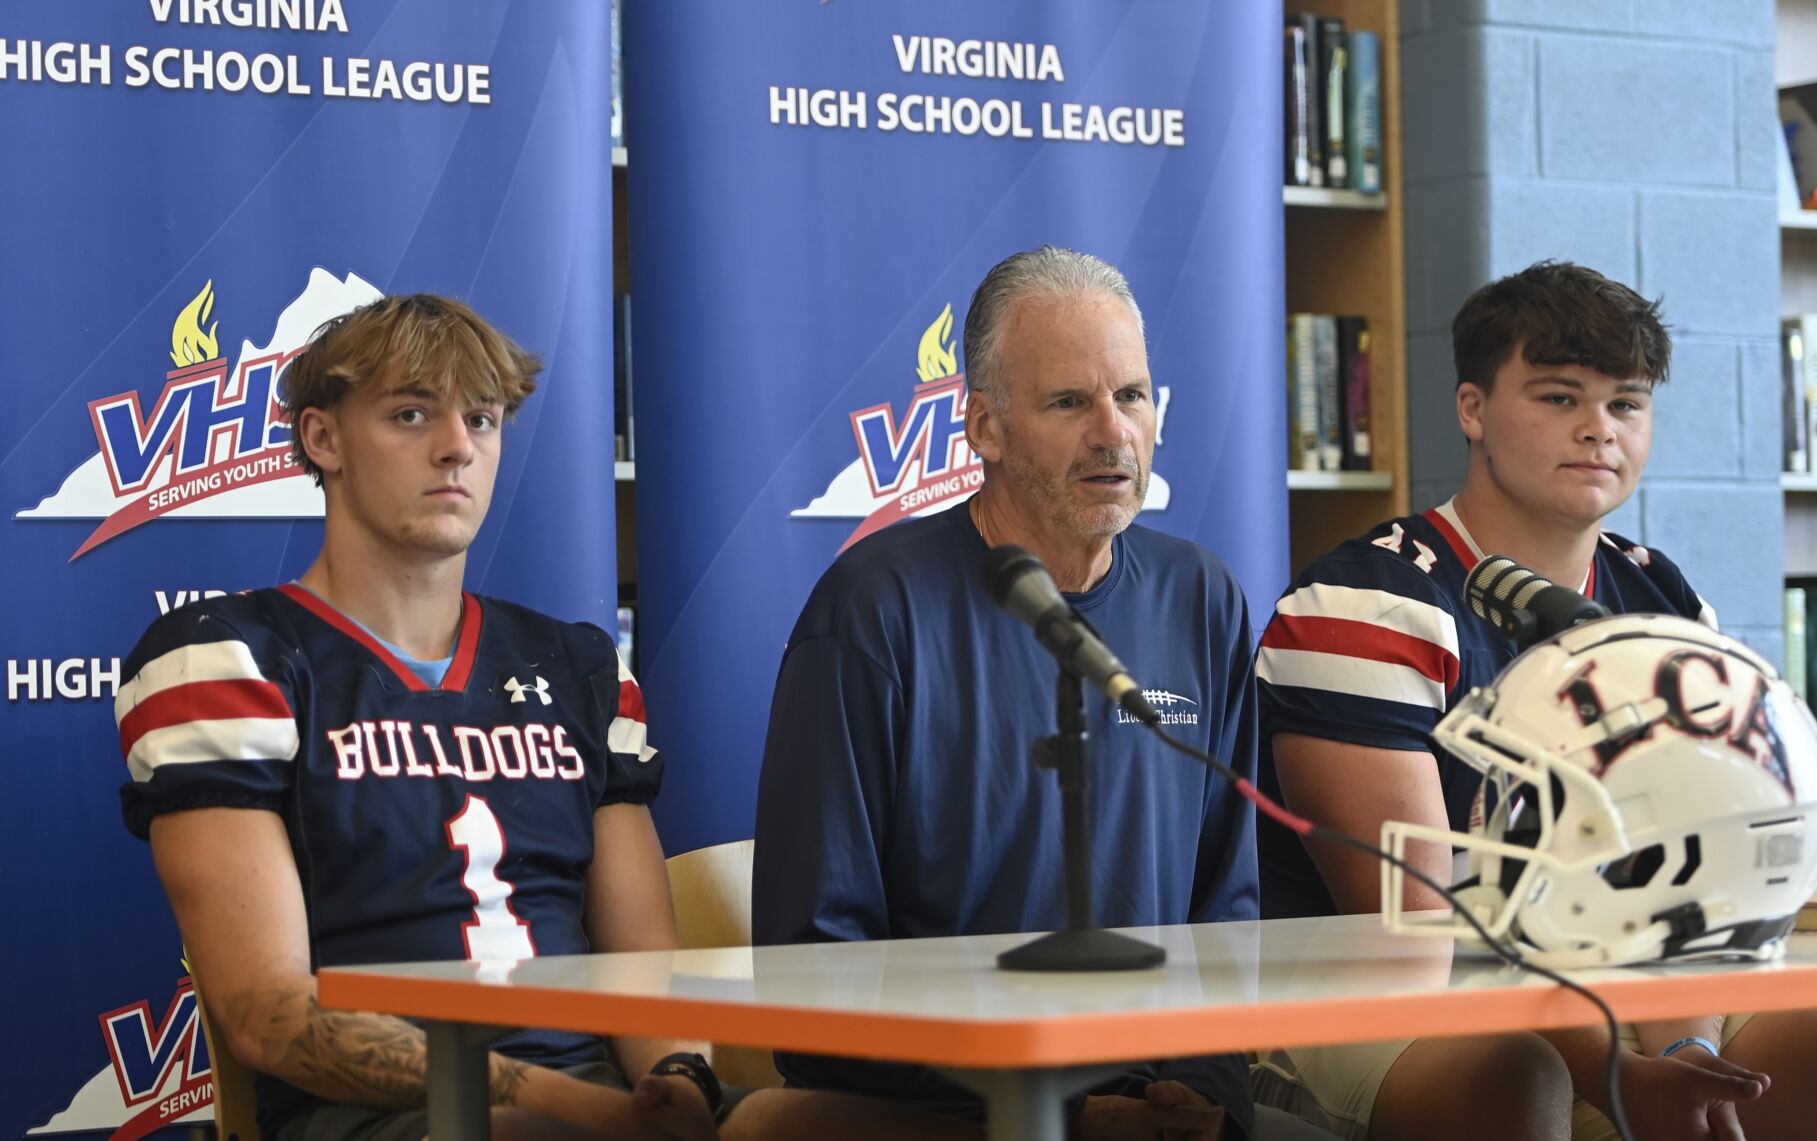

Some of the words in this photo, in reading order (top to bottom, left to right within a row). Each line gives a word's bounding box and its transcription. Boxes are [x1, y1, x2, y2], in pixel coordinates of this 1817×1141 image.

[149, 0, 349, 33] VIRGINIA
[0, 39, 111, 85] HIGH
[124, 47, 311, 95] SCHOOL
[322, 56, 491, 104] LEAGUE
[892, 34, 1065, 82] VIRGINIA
[769, 86, 867, 129] HIGH
[876, 92, 1034, 138] SCHOOL
[1041, 102, 1185, 146] LEAGUE
[148, 472, 222, 511] SERVING
[223, 455, 281, 484] YOUTH
[899, 479, 960, 512] SERVING
[7, 657, 121, 700] HIGH
[327, 719, 585, 781] BULLDOGS
[444, 792, 538, 961] 1
